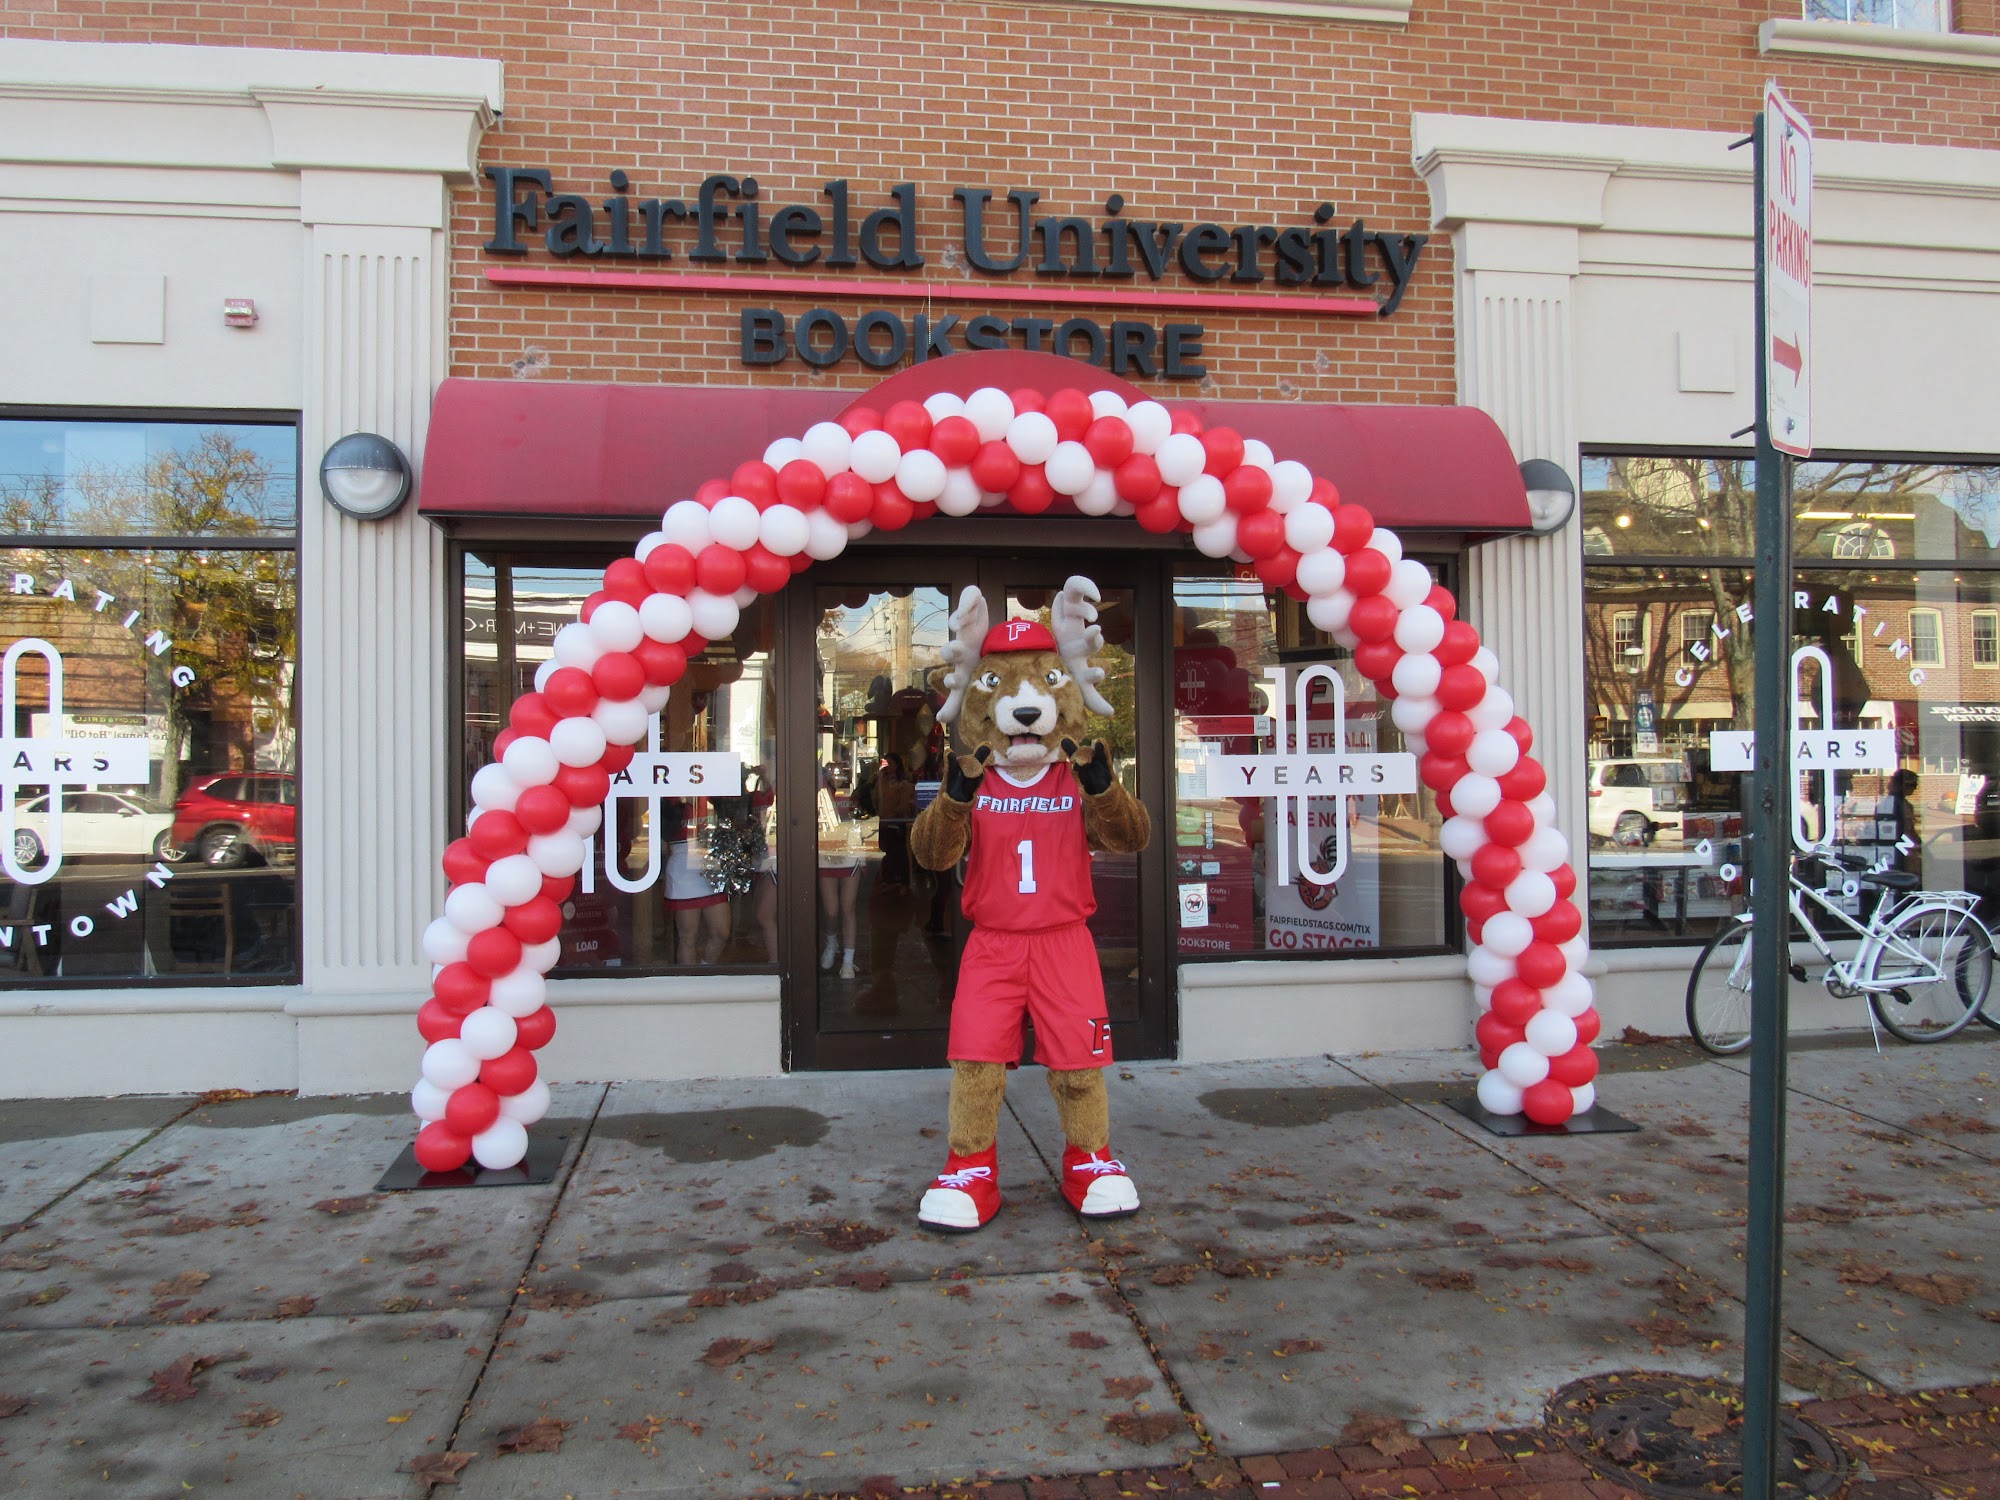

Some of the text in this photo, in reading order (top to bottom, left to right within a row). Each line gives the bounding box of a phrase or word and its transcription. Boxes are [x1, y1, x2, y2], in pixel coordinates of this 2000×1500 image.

[1780, 134, 1797, 206] NO
[484, 166, 1429, 317] Fairfield University
[1768, 198, 1809, 288] PARKING
[741, 307, 1207, 379] BOOKSTORE
[1674, 591, 1927, 686] CELERATING
[1240, 764, 1385, 786] YEARS
[1740, 740, 1868, 761] YARS
[976, 795, 1074, 814] FAIRFIELD
[1016, 839, 1037, 895] 1
[1269, 915, 1371, 935] FAIRFIELDSTAGS.COM/TIX
[1269, 929, 1298, 949] GO
